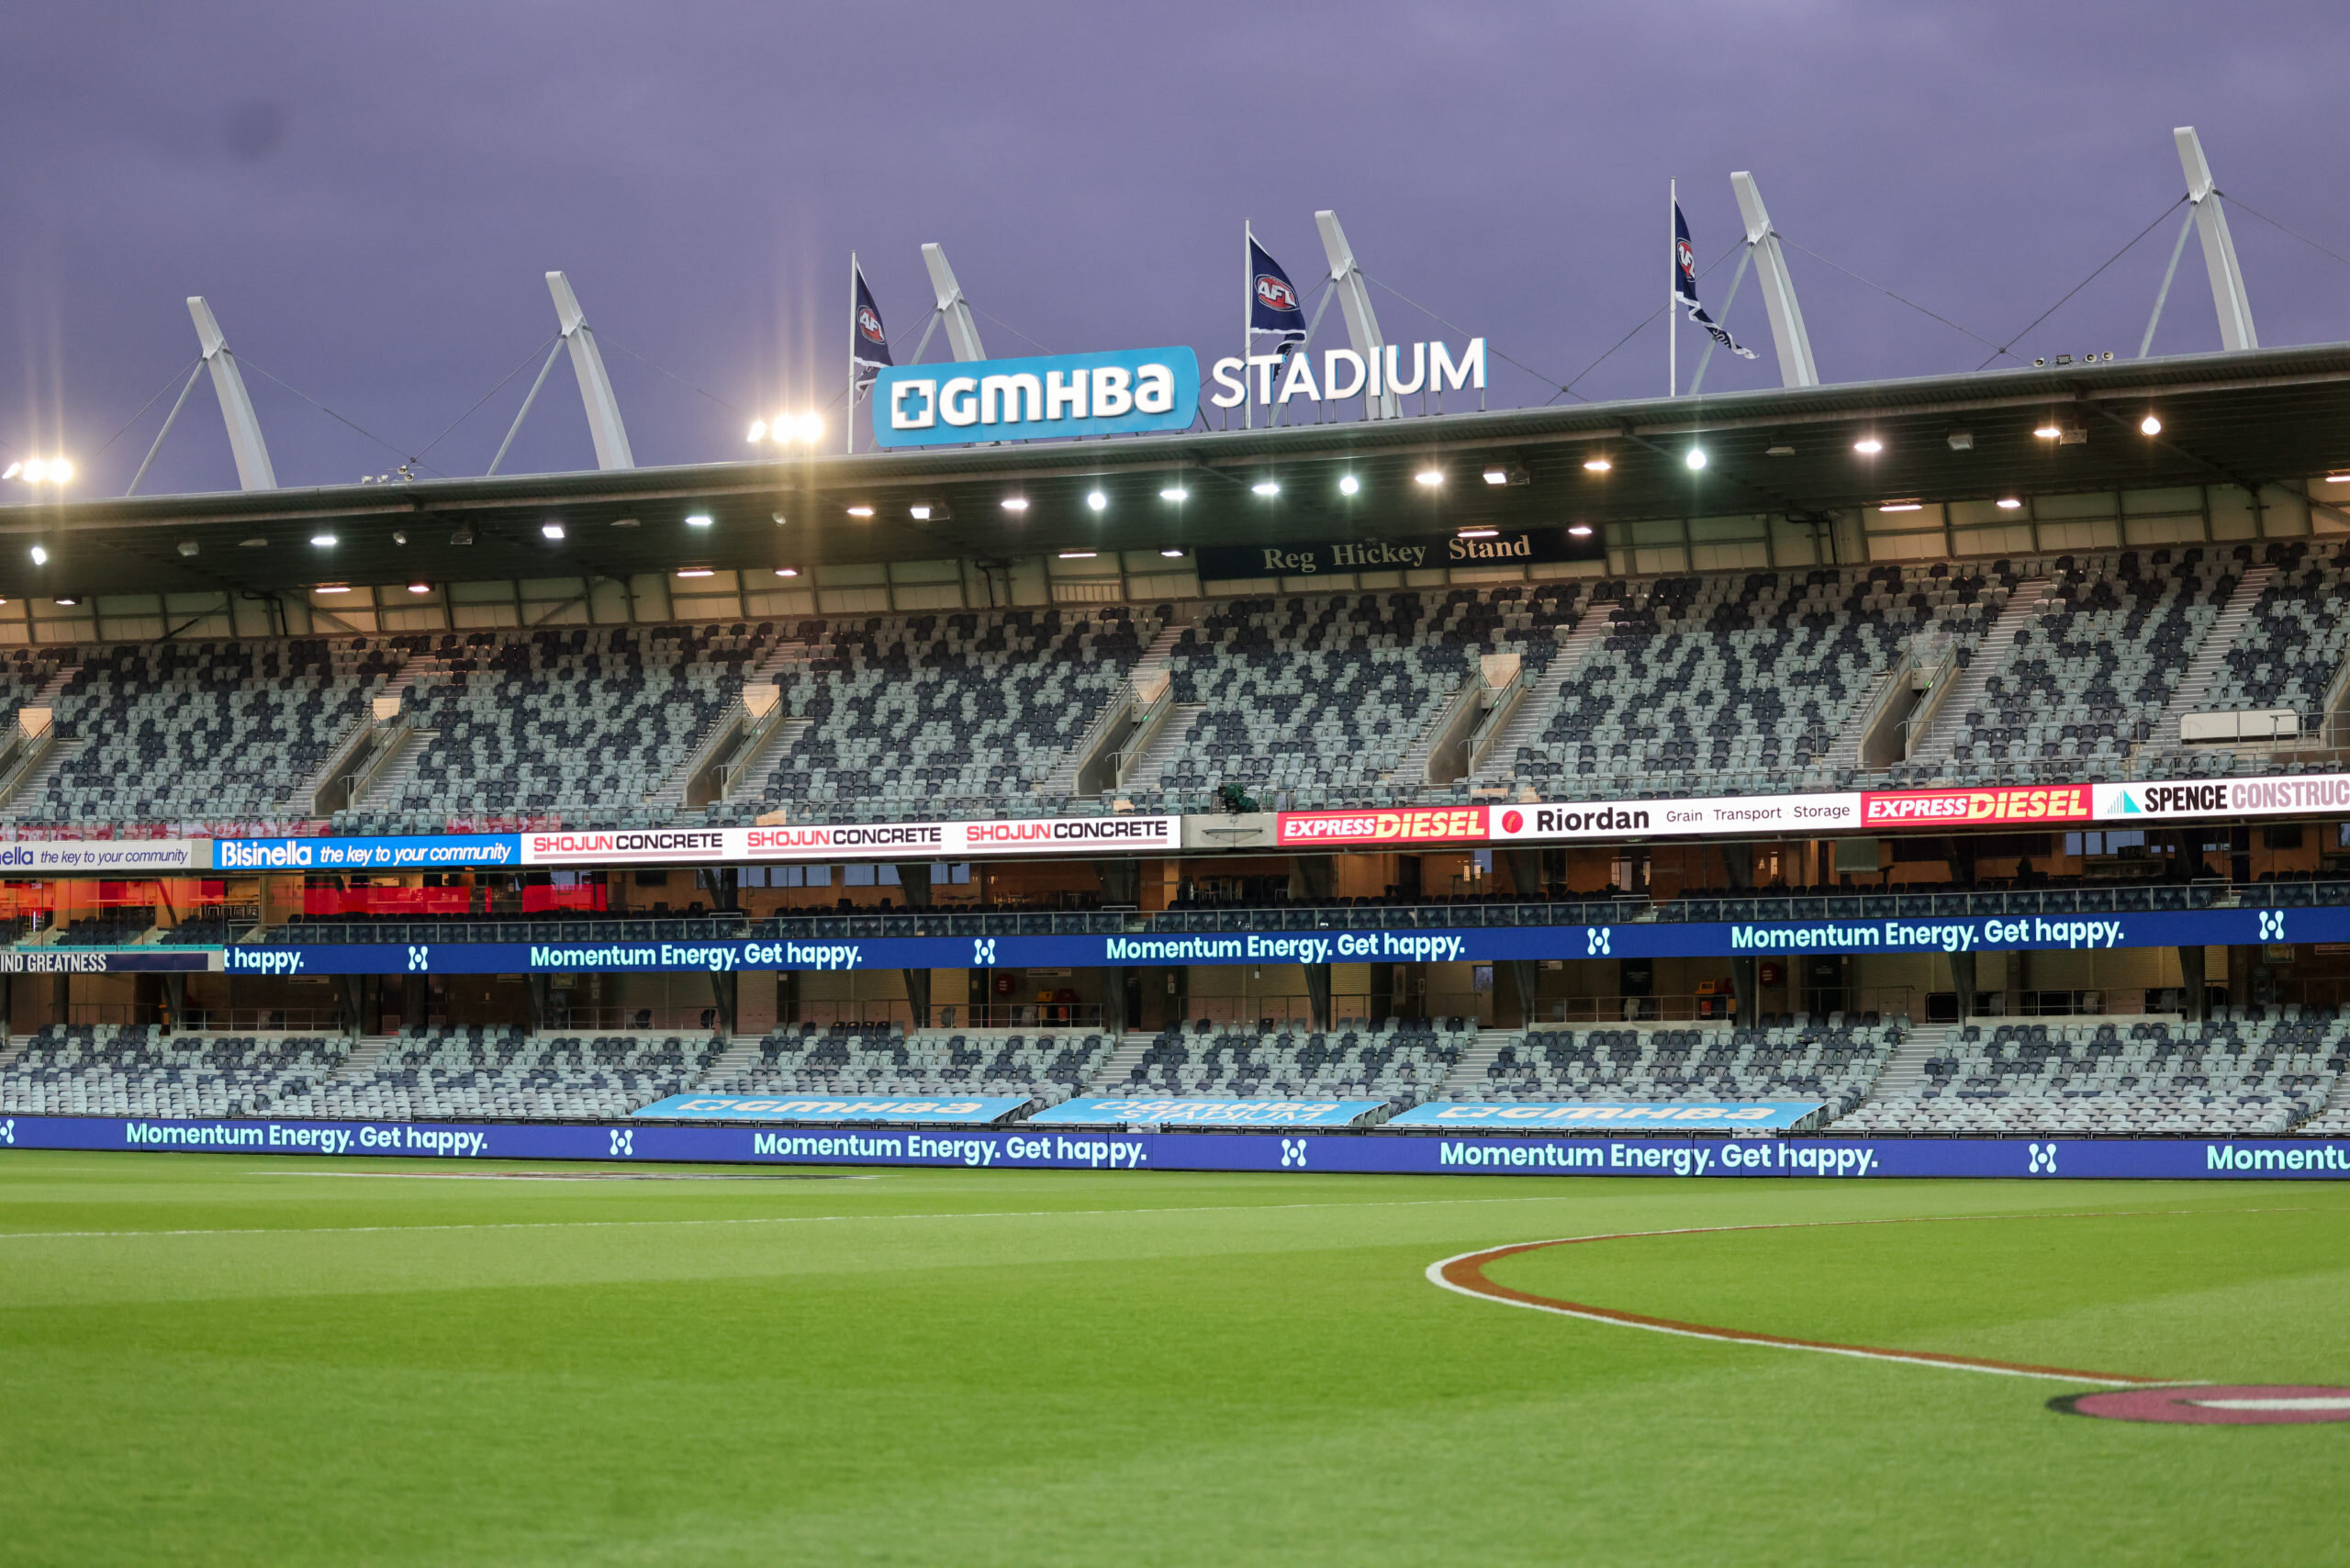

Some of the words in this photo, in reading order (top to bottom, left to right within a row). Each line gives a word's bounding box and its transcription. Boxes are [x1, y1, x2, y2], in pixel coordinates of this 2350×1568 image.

[1211, 337, 1487, 408] STADIUM
[1263, 549, 1315, 572] Reg
[1332, 543, 1426, 566] Hickey
[1449, 535, 1531, 560] Stand
[1868, 797, 1968, 818] EXPRESS
[1968, 790, 2087, 819] DIESEL
[2145, 785, 2227, 812] SPENCE
[2232, 780, 2350, 809] CONSTRUC
[967, 824, 1050, 841] SHOJUN
[1055, 821, 1167, 838] CONCRETE
[1284, 817, 1375, 837] EXPRESS
[1375, 810, 1485, 837] DIESEL
[1538, 807, 1649, 831] Riordan
[1667, 811, 1702, 822] Grain
[1714, 808, 1782, 822] Transport
[1795, 806, 1850, 819] Storage
[533, 833, 612, 852] SHOJUN
[616, 834, 722, 849] CONCRETE
[748, 830, 830, 846] SHOJUN
[834, 827, 941, 845] CONCRETE
[0, 846, 33, 865] ella
[41, 851, 59, 863] the
[62, 851, 81, 866] key
[84, 851, 95, 862] to
[97, 853, 124, 866] your
[126, 849, 188, 864] community
[222, 841, 311, 866] Bisinella
[320, 846, 343, 862] the
[346, 846, 373, 866] key
[375, 846, 390, 861] to
[393, 848, 428, 864] your
[430, 843, 511, 863] community
[1107, 937, 1241, 958] Momentum
[1248, 935, 1332, 963] Energy.
[1337, 935, 1378, 955] Get
[1384, 933, 1464, 961] happy.
[1732, 926, 1879, 947] Momentum
[1886, 923, 1978, 951] Energy.
[1985, 920, 2029, 942] Get
[2036, 918, 2123, 948] happy.
[27, 953, 107, 972] GREATNESS
[235, 947, 304, 974] happy.
[532, 946, 655, 966] Momentum
[662, 945, 740, 970] Energy.
[744, 944, 782, 963] Get
[788, 942, 862, 969] happy.
[1113, 1110, 1329, 1122] STADIUM
[127, 1123, 263, 1145] Momentum
[270, 1125, 354, 1153] Energy.
[360, 1126, 400, 1147] Get
[408, 1128, 487, 1156] happy.
[755, 1134, 901, 1156] Momentum
[909, 1136, 1001, 1165] Energy.
[1007, 1137, 1050, 1159] Get
[1058, 1137, 1147, 1168] happy.
[1441, 1143, 1603, 1166] Momentum
[1611, 1144, 1714, 1175] Energy.
[1721, 1144, 1771, 1167] Get
[1778, 1143, 1877, 1175] happy.
